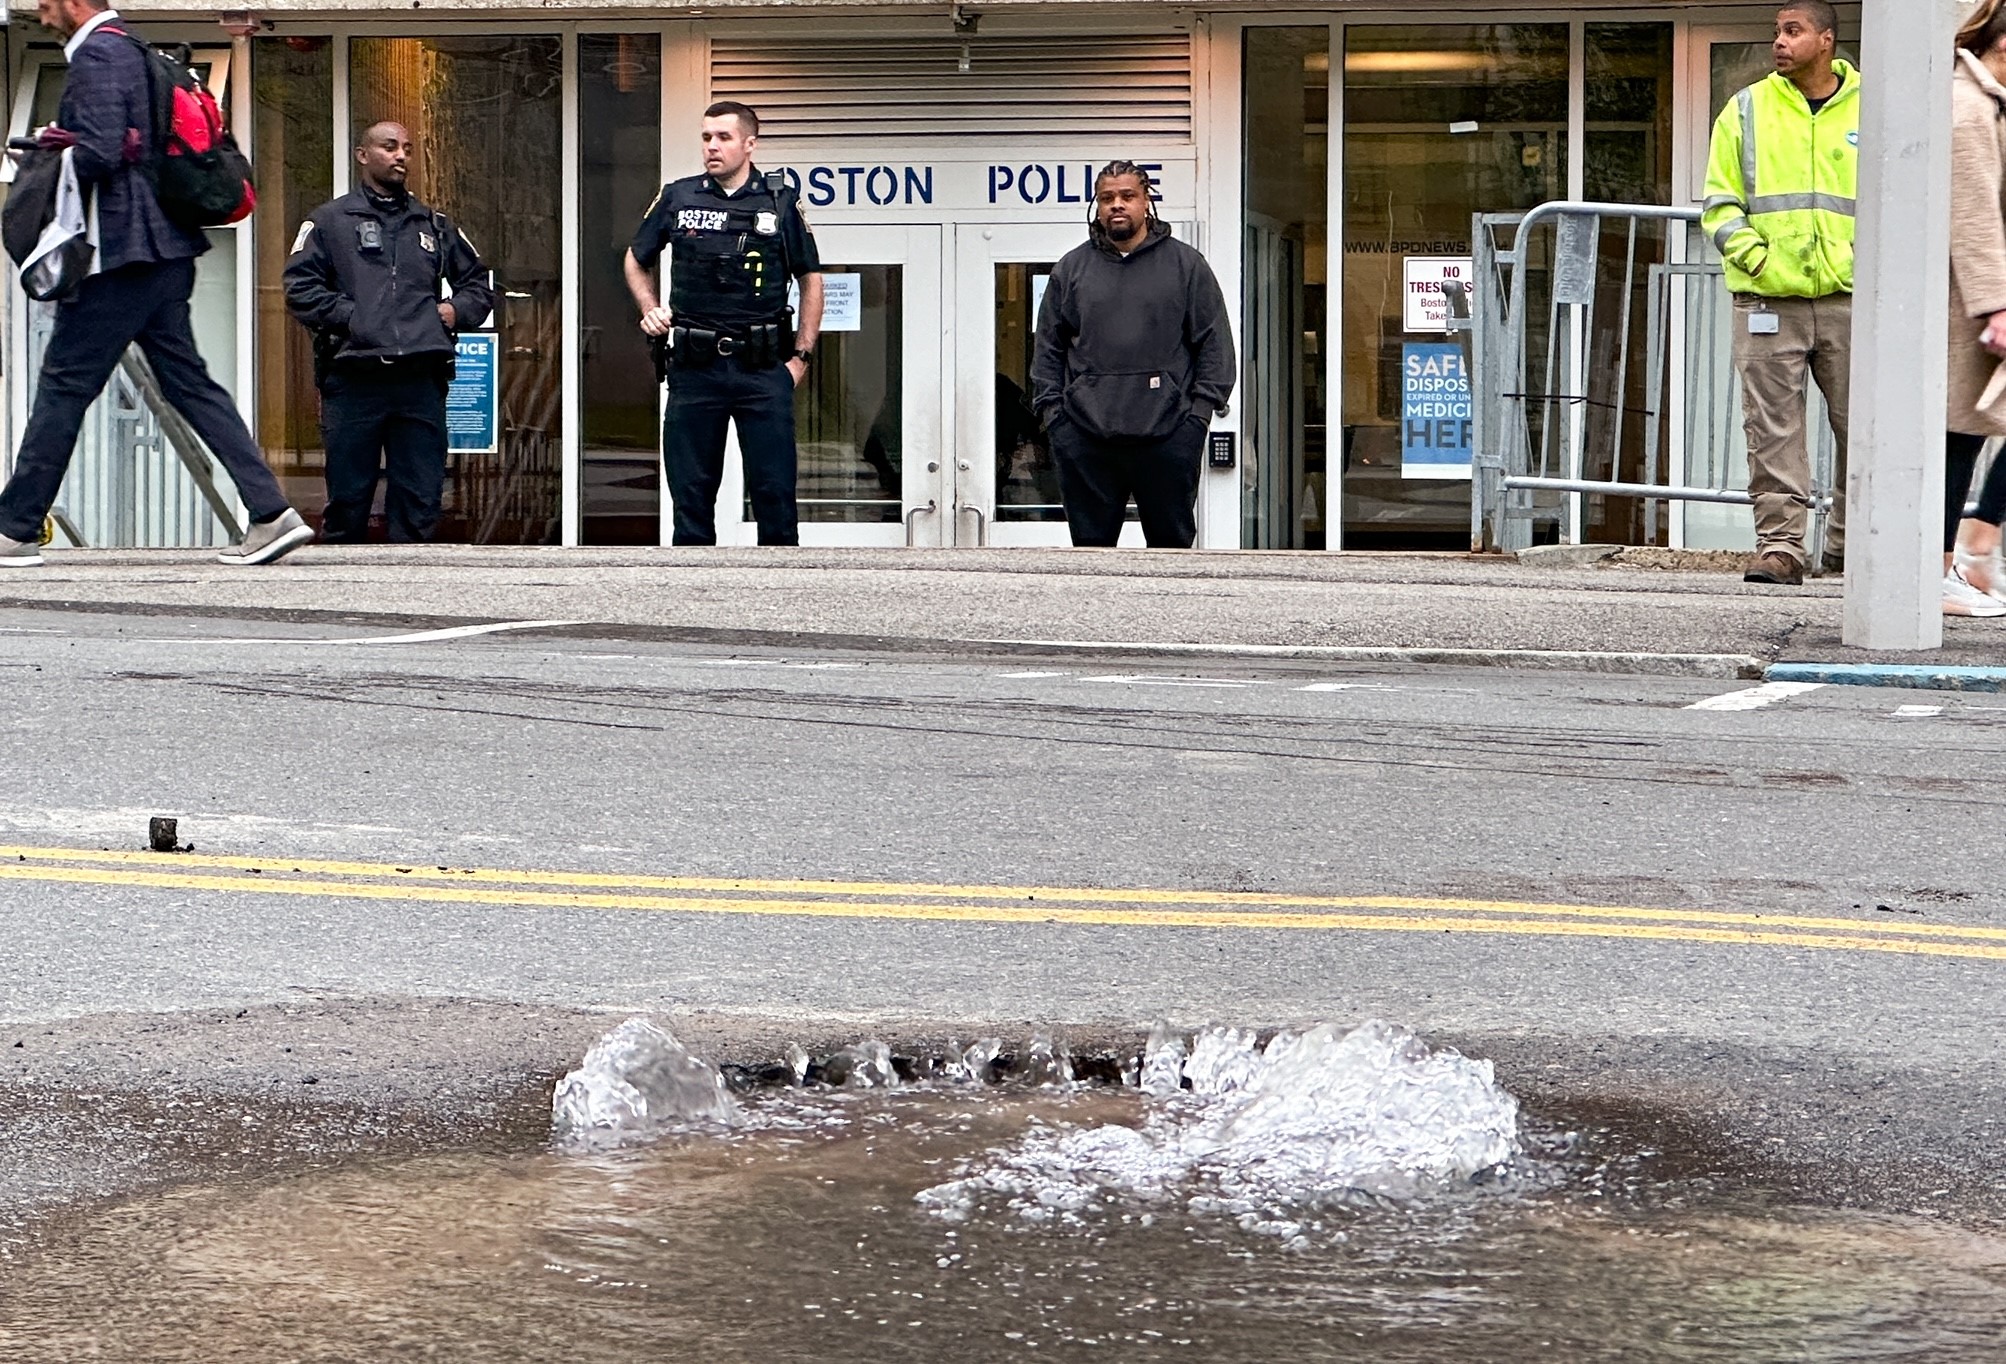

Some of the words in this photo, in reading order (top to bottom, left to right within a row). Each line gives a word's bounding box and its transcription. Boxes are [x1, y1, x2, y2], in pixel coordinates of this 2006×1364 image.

[775, 166, 932, 206] OSTON
[989, 164, 1163, 204] POLIE
[678, 210, 727, 221] BOSTON
[678, 219, 722, 230] POLICE
[1345, 241, 1507, 254] WWW.BPDNEWS.
[1443, 266, 1460, 278] NO
[1421, 298, 1447, 307] Bosto
[455, 343, 488, 355] TICE
[1406, 378, 1468, 392] DISPOS
[1406, 393, 1443, 401] EXPIRED
[1443, 393, 1457, 401] OR
[1458, 393, 1471, 401] UN
[1406, 402, 1472, 418] MEDICI
